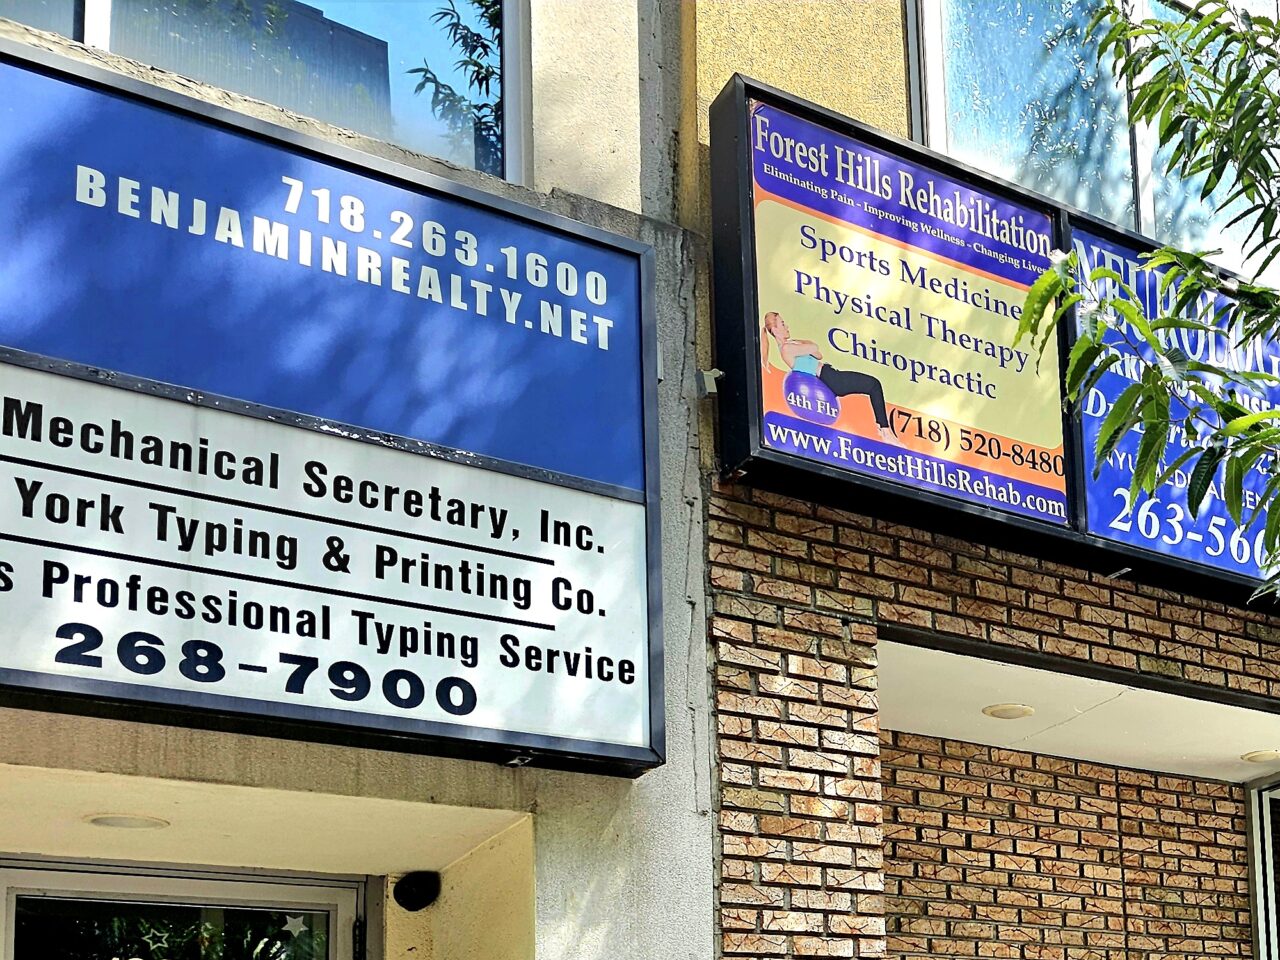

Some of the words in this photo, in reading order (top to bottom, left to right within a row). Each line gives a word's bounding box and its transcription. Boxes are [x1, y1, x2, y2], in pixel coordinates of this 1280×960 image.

[755, 113, 828, 177] Forest
[835, 145, 892, 200] Hills
[898, 170, 1051, 258] Rehabilitation
[763, 163, 828, 198] Eliminating
[830, 188, 854, 207] Pain
[864, 201, 918, 232] Improving
[920, 223, 965, 247] Wellness
[973, 242, 1020, 268] Changing
[75, 165, 614, 350] BENJAMINREALTY.NET
[281, 176, 608, 306] 718.263.1600
[800, 225, 891, 277] Sports
[899, 259, 1023, 321] Medicine
[794, 269, 912, 331] Physical
[920, 312, 1029, 372] Therapy
[828, 327, 997, 399] Chiropractic
[787, 391, 813, 411] 4th
[816, 398, 838, 418] Flr
[889, 407, 950, 451] (718)
[960, 428, 1065, 477] 520-8480
[2, 396, 280, 490] Mechanical
[303, 460, 520, 542] Secretary,
[540, 509, 605, 553] Inc.
[767, 423, 1066, 518] www.ForestHillsRehab.com
[14, 476, 125, 533] York
[149, 503, 298, 570] Typing
[322, 537, 350, 574] &
[374, 543, 532, 610] Printing
[551, 577, 606, 617] Co.
[43, 560, 331, 639] Professional
[351, 610, 479, 667] Typing
[500, 636, 636, 685] Service
[55, 621, 478, 716] 268-7900
